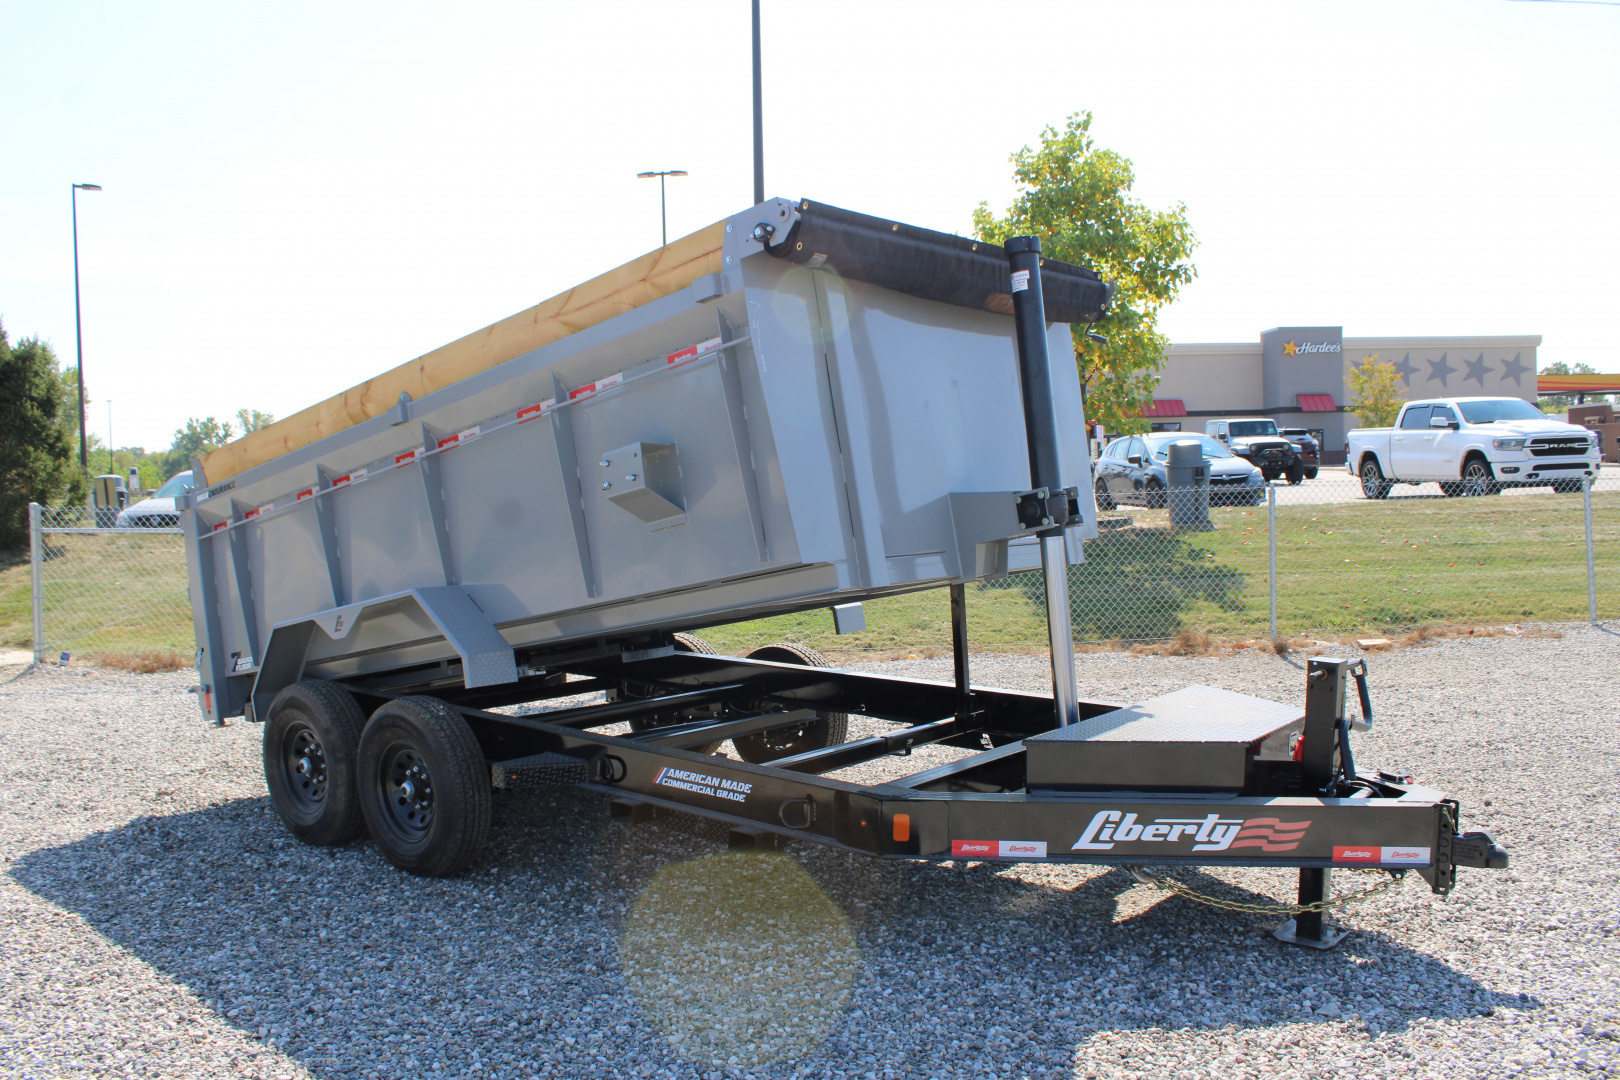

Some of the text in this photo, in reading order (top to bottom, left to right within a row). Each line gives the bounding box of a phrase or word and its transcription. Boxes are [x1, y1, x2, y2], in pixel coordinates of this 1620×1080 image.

[231, 651, 242, 672] 7
[662, 777, 746, 802] COMMERCIAL GRADE
[667, 768, 753, 793] AMERICAN MADE
[1071, 810, 1244, 852] Liberty
[1342, 850, 1366, 858] Liberty
[1391, 851, 1414, 859] Liberty
